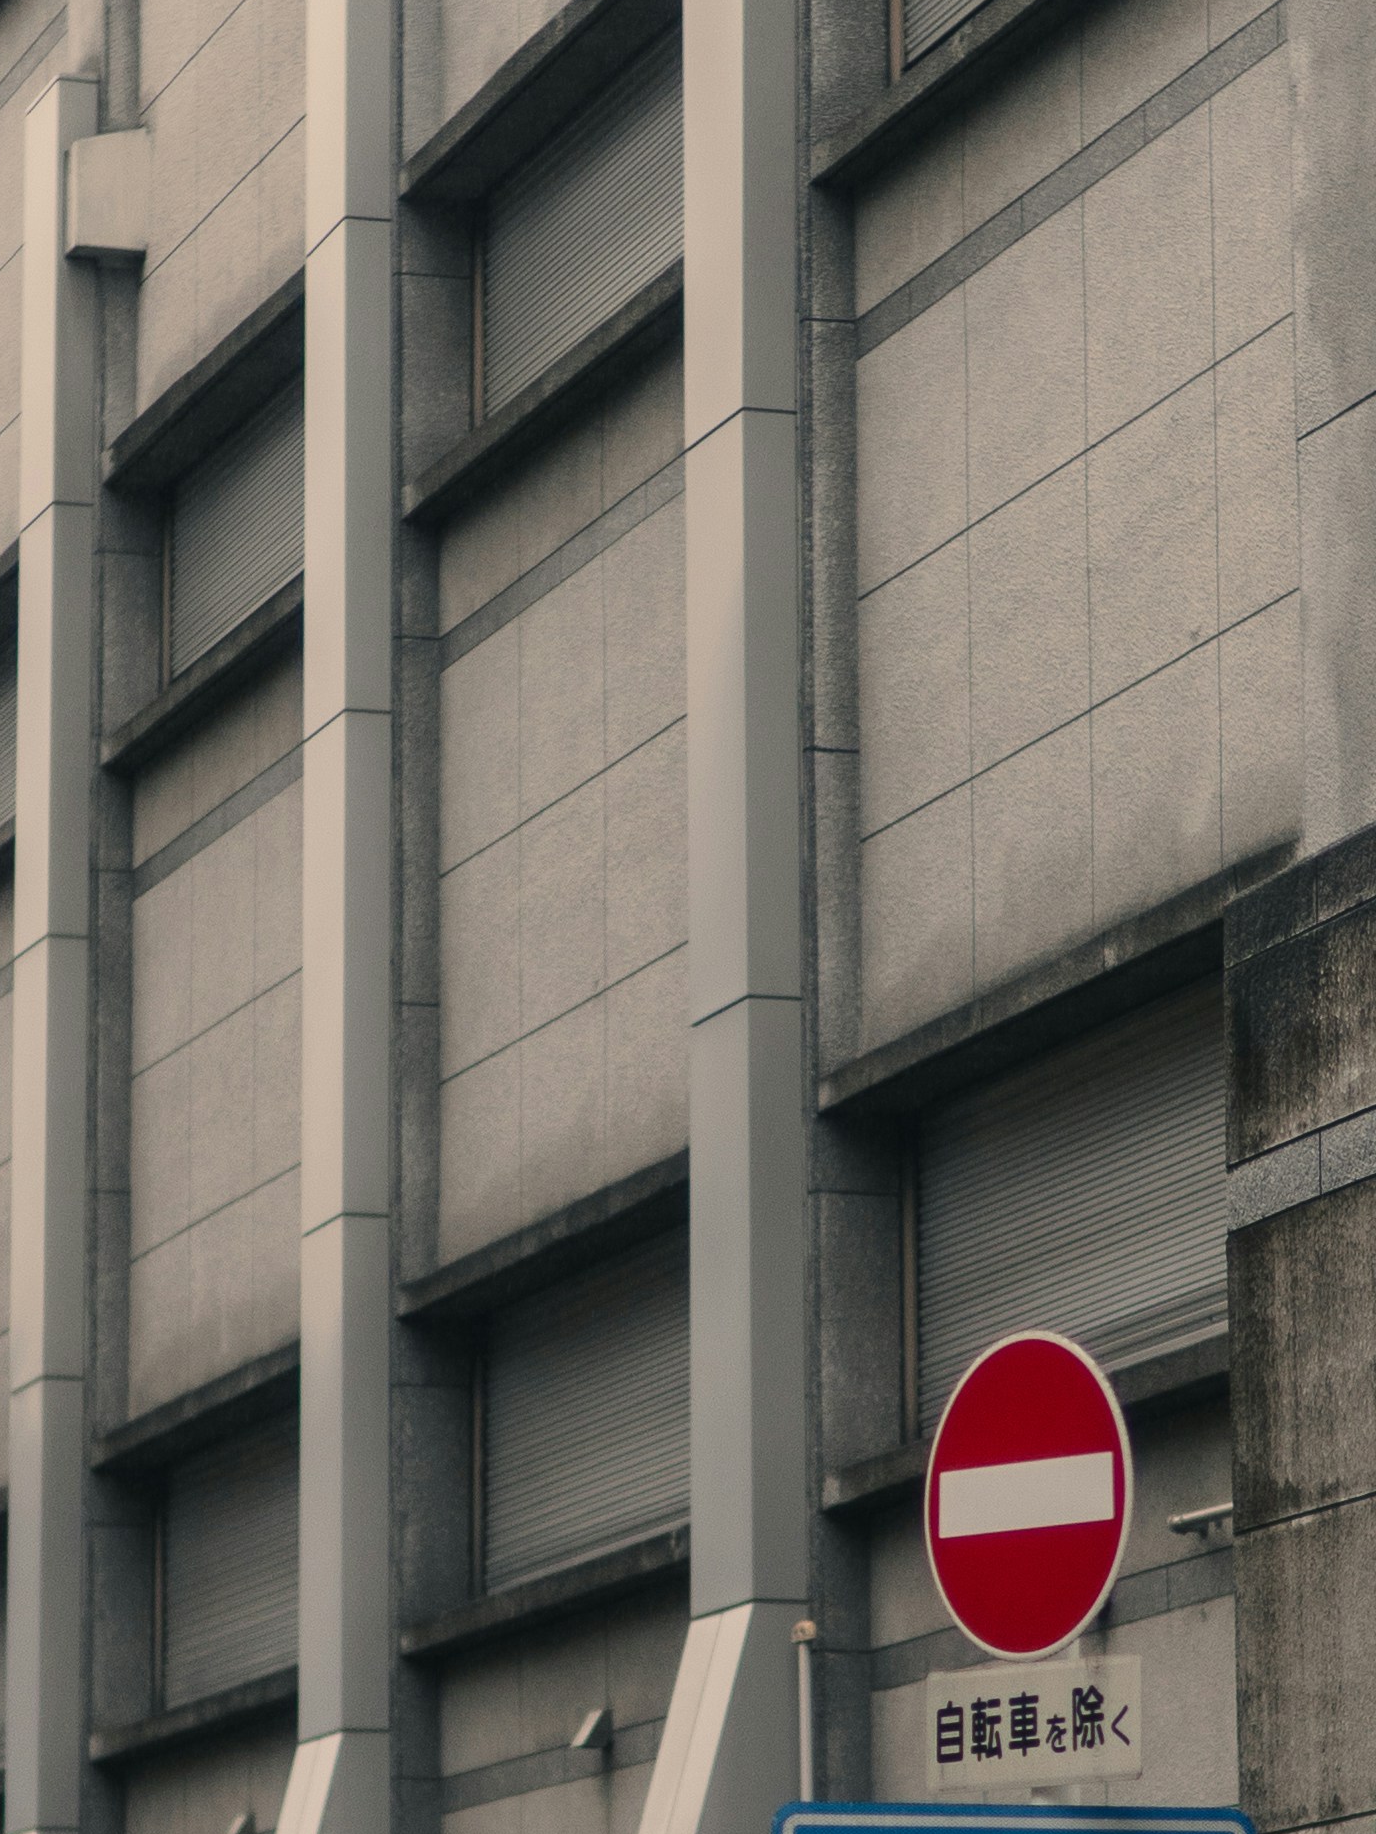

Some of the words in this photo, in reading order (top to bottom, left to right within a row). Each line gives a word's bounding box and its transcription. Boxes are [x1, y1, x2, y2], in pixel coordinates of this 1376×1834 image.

[936, 1684, 1131, 1764] 自転車を除く
